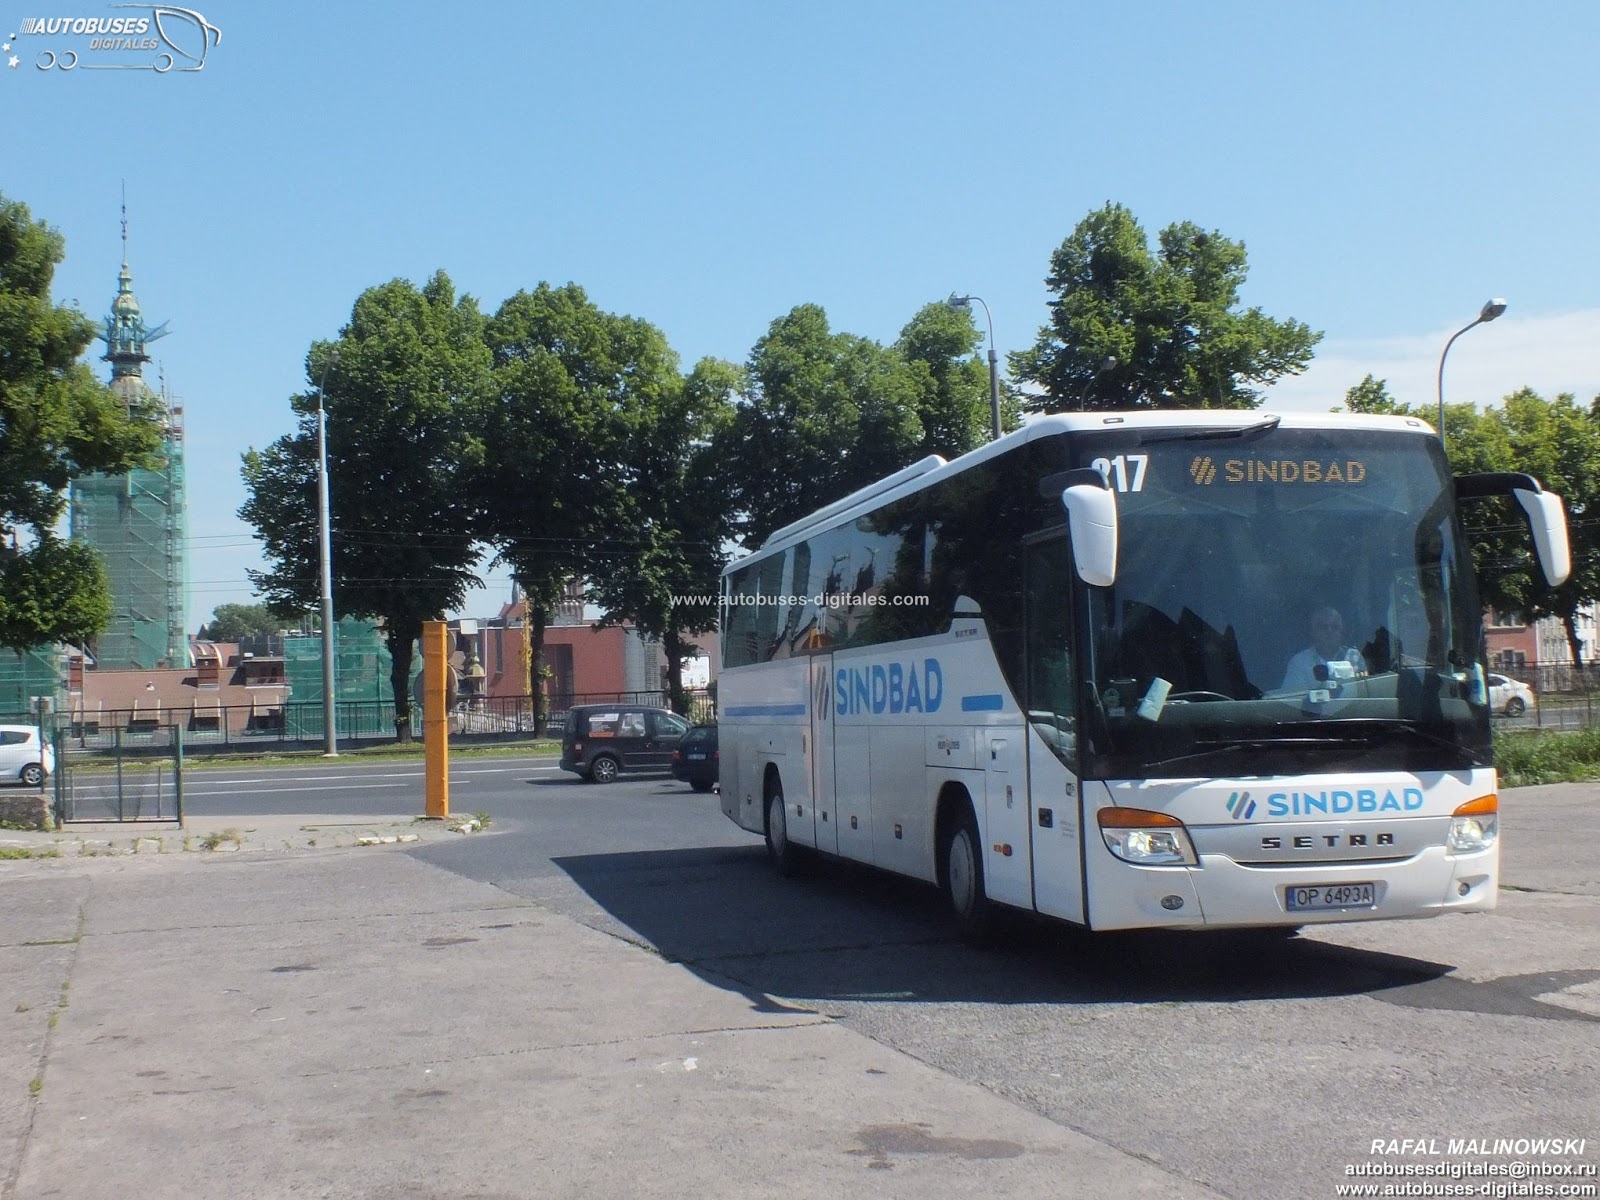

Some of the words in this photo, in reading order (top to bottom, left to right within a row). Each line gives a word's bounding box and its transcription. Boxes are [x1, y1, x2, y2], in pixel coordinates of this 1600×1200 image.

[1225, 459, 1366, 482] SINDBAD
[835, 658, 943, 715] SINDBAD
[1268, 788, 1423, 817] SINDBAD
[1261, 833, 1394, 850] SETRA
[1297, 889, 1319, 905] OP
[1325, 887, 1370, 904] 6493A
